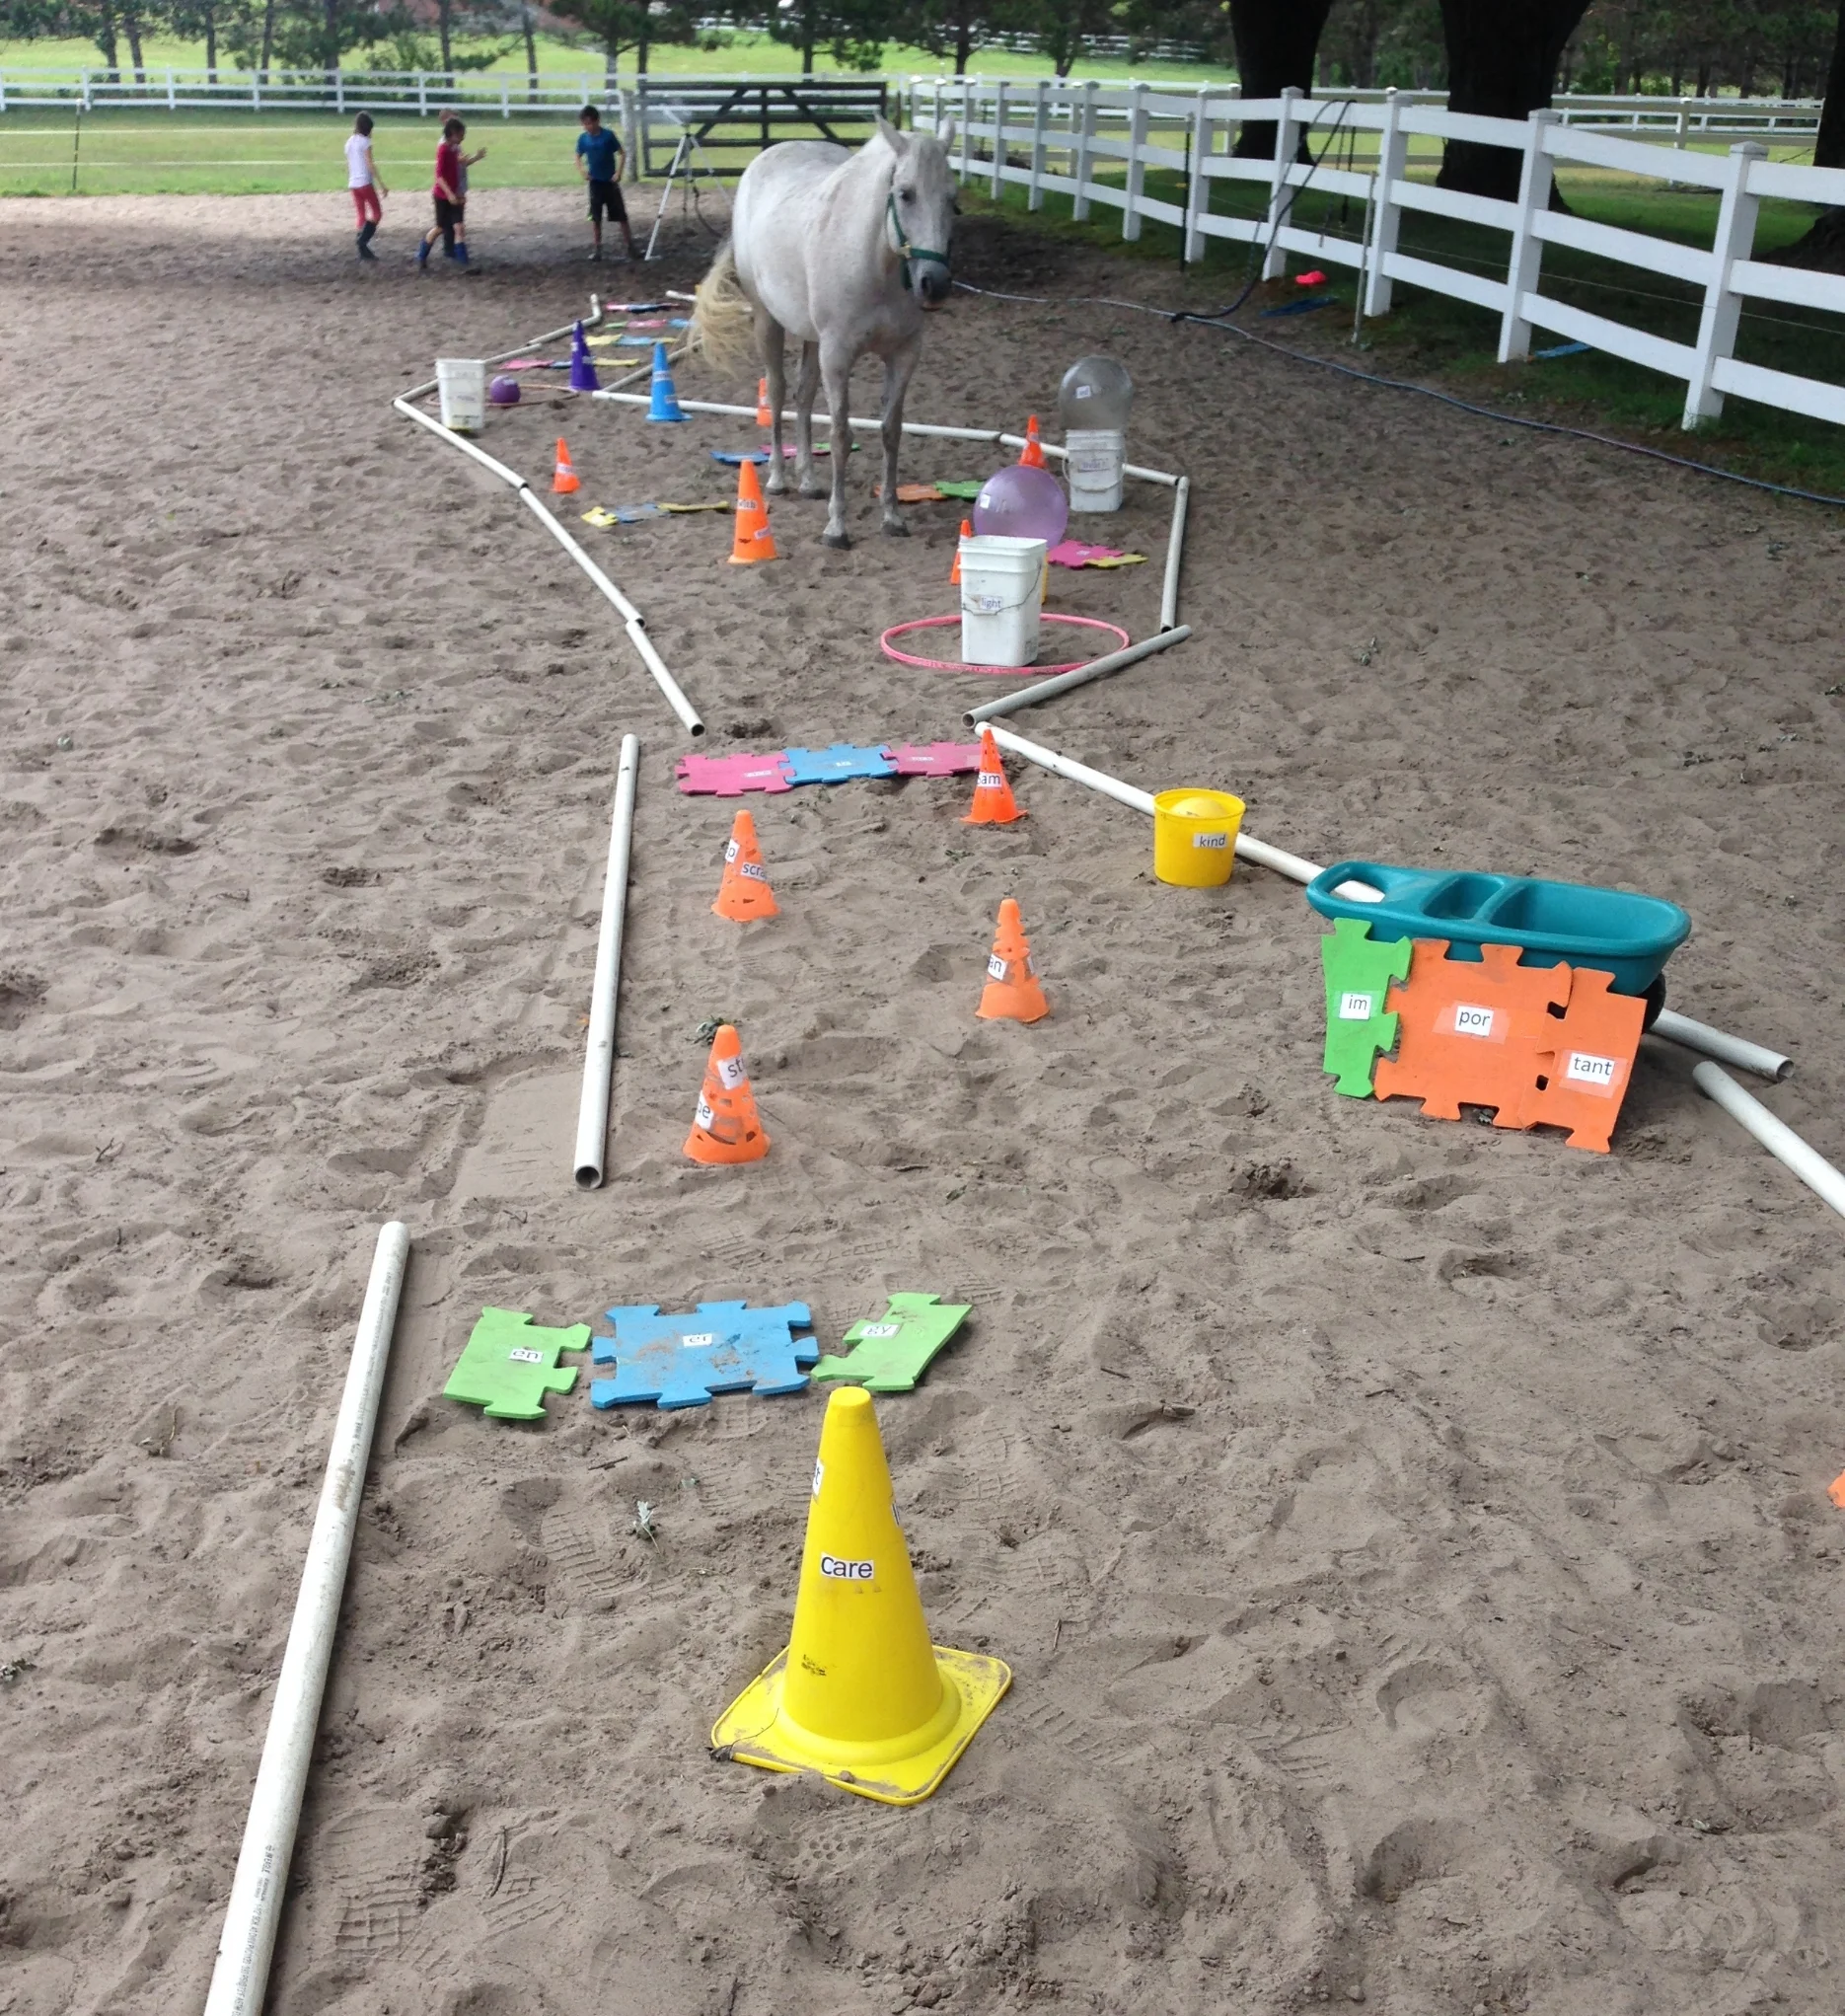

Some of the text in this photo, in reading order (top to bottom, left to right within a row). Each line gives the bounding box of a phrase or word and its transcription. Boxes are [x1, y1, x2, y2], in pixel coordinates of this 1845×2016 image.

[981, 597, 1001, 609] light
[1199, 834, 1226, 848] kind
[1348, 995, 1612, 1077] im por tant
[727, 1058, 745, 1078] st
[512, 1325, 892, 1361] en er gy
